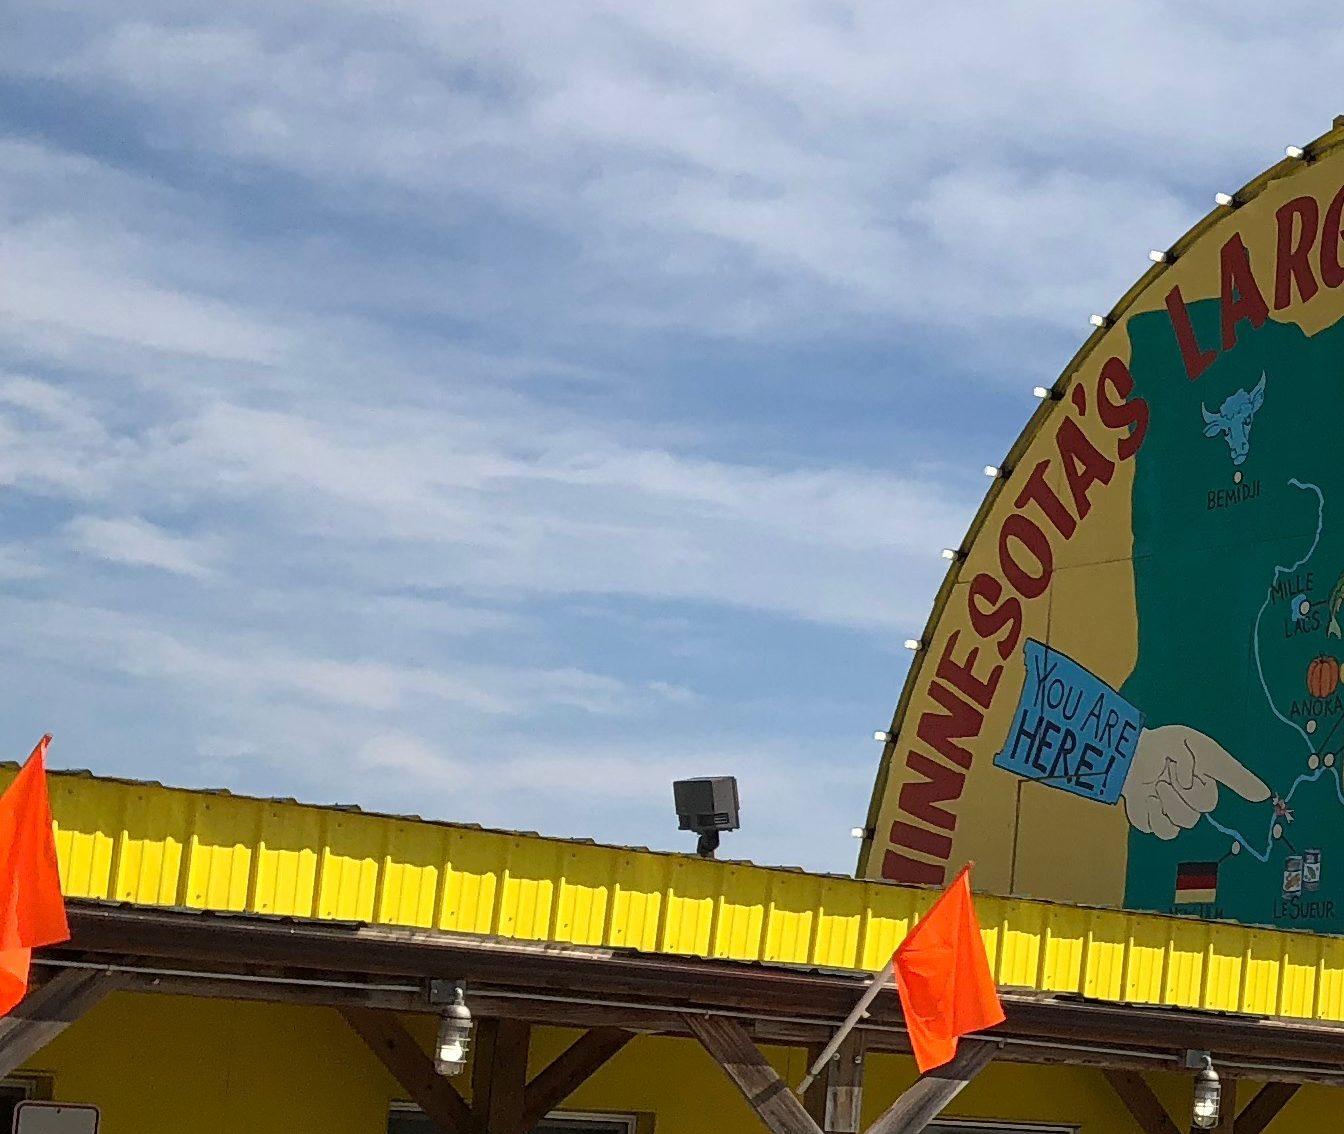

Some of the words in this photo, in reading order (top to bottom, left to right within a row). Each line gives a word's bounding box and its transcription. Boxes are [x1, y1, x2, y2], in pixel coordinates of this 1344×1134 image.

[1207, 481, 1260, 511] BEMIDJI
[1270, 573, 1313, 604] MILLE
[1283, 612, 1320, 639] LACS
[1033, 655, 1083, 721] YOU
[1080, 692, 1137, 759] ARE
[1290, 696, 1344, 718] ANOKA
[1009, 708, 1116, 795] HERE!
